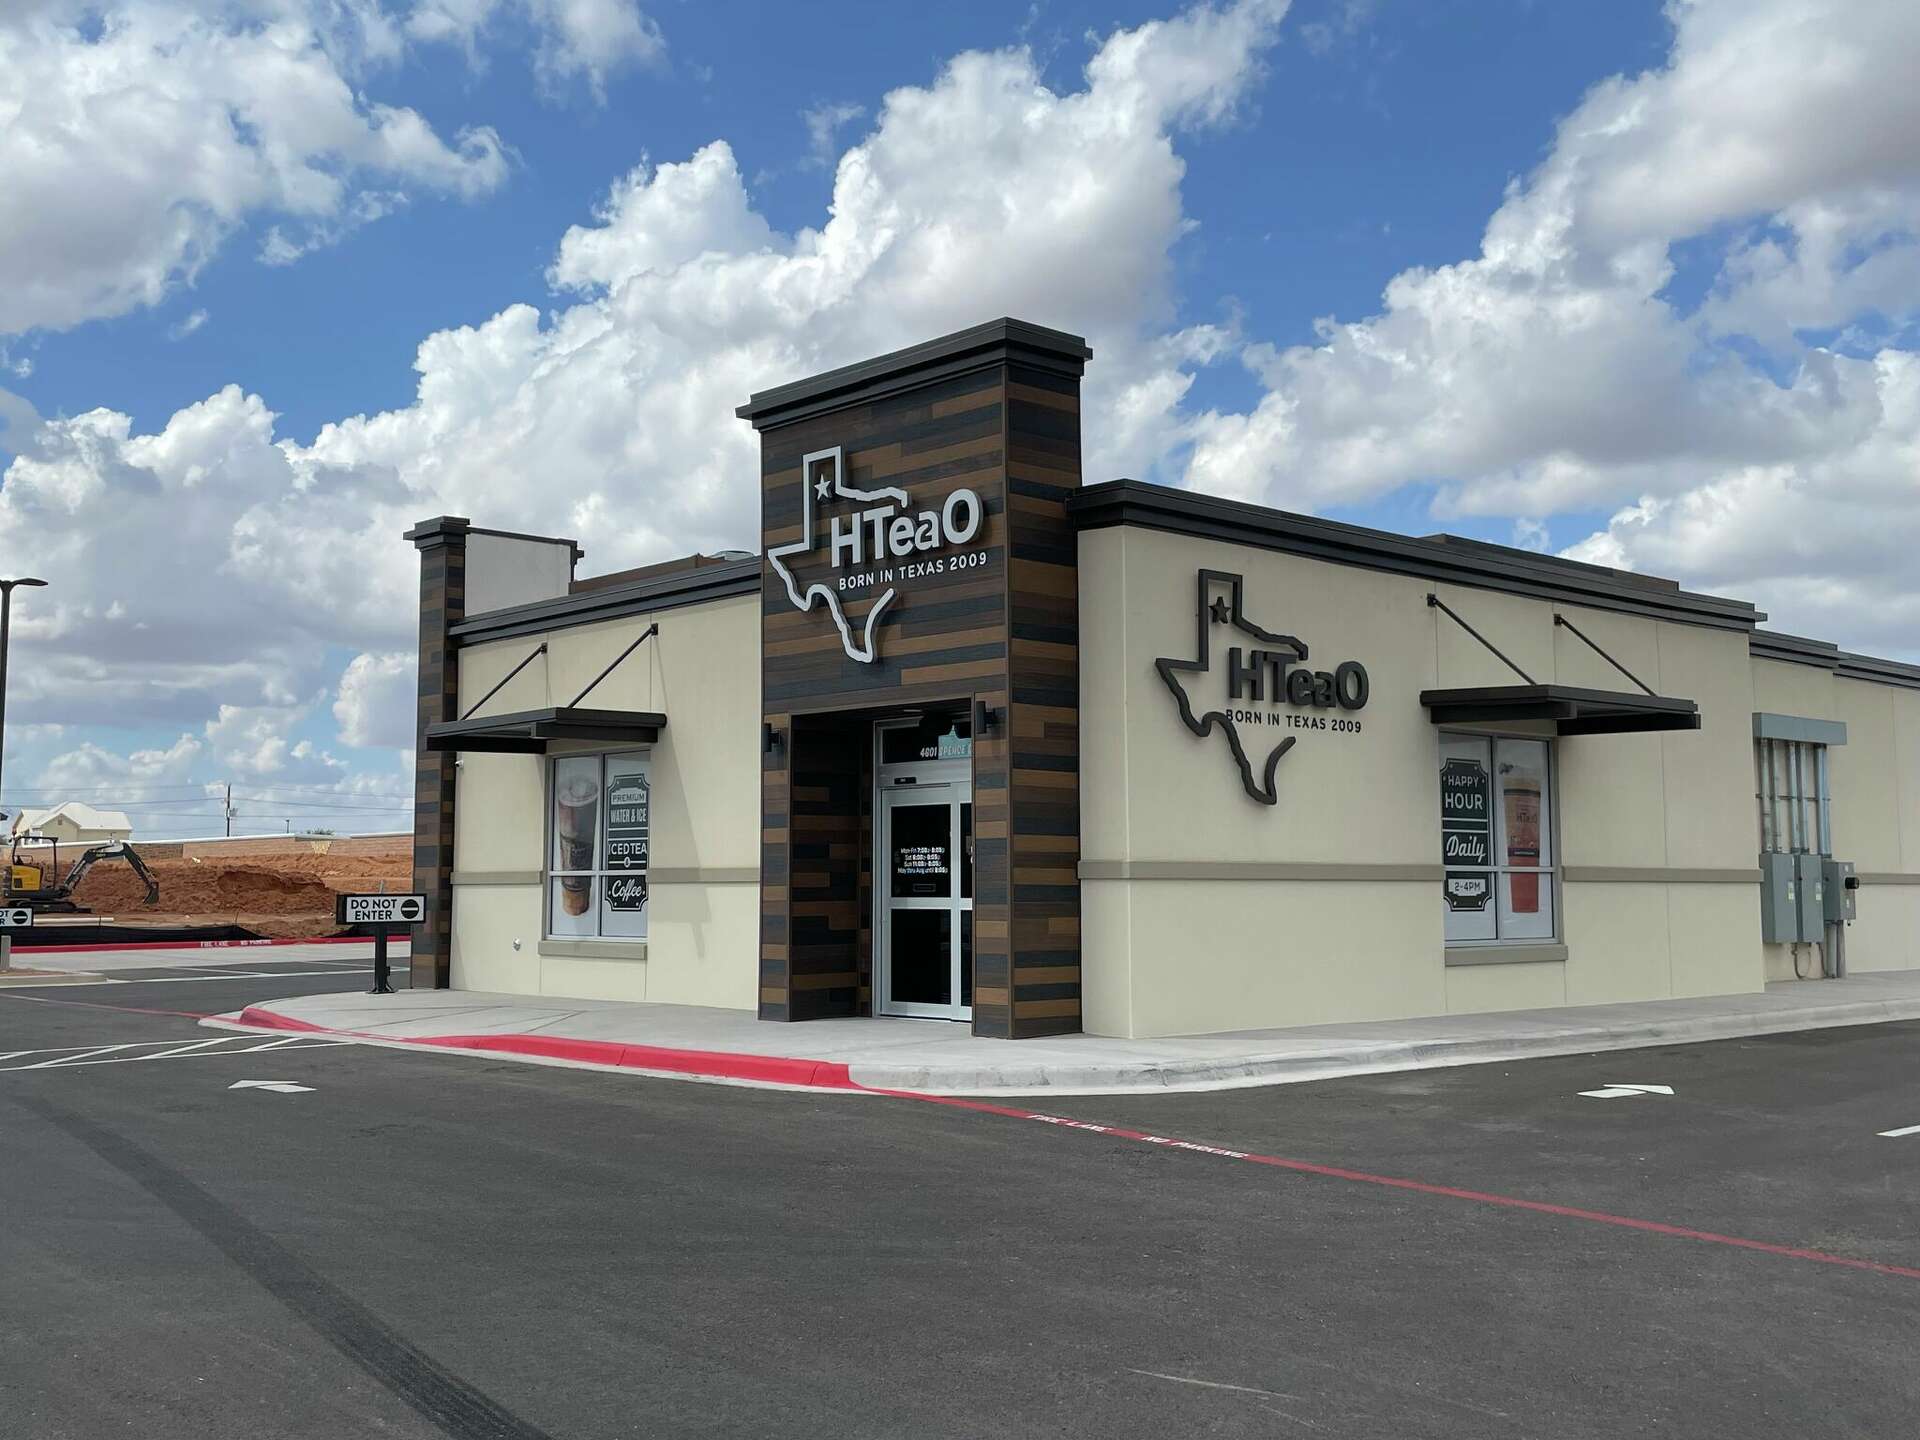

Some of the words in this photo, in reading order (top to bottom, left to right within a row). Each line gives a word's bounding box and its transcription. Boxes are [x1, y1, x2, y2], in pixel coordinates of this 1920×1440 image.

[831, 488, 982, 568] HTeaO
[839, 572, 874, 591] BORN
[880, 569, 893, 583] IN
[899, 559, 944, 579] TEXAS
[950, 551, 987, 571] 2009
[1228, 647, 1370, 711] HTeaO
[1226, 709, 1262, 724] BORN
[1267, 713, 1280, 726] IN
[1286, 715, 1326, 730] TEXAS
[1331, 719, 1362, 733] 2009
[1448, 775, 1479, 788] HAPPY
[613, 793, 645, 802] PREMIUM
[1445, 792, 1483, 810] HOUR
[610, 808, 630, 823] WATER
[630, 808, 636, 822] &
[636, 808, 647, 822] ICE
[1446, 834, 1486, 863] Daily
[611, 879, 642, 902] Coffee
[1454, 881, 1481, 892] 2-4PM
[351, 899, 369, 909] DO
[372, 899, 397, 909] NOT
[0, 910, 10, 918] OT
[355, 910, 392, 920] ENTER
